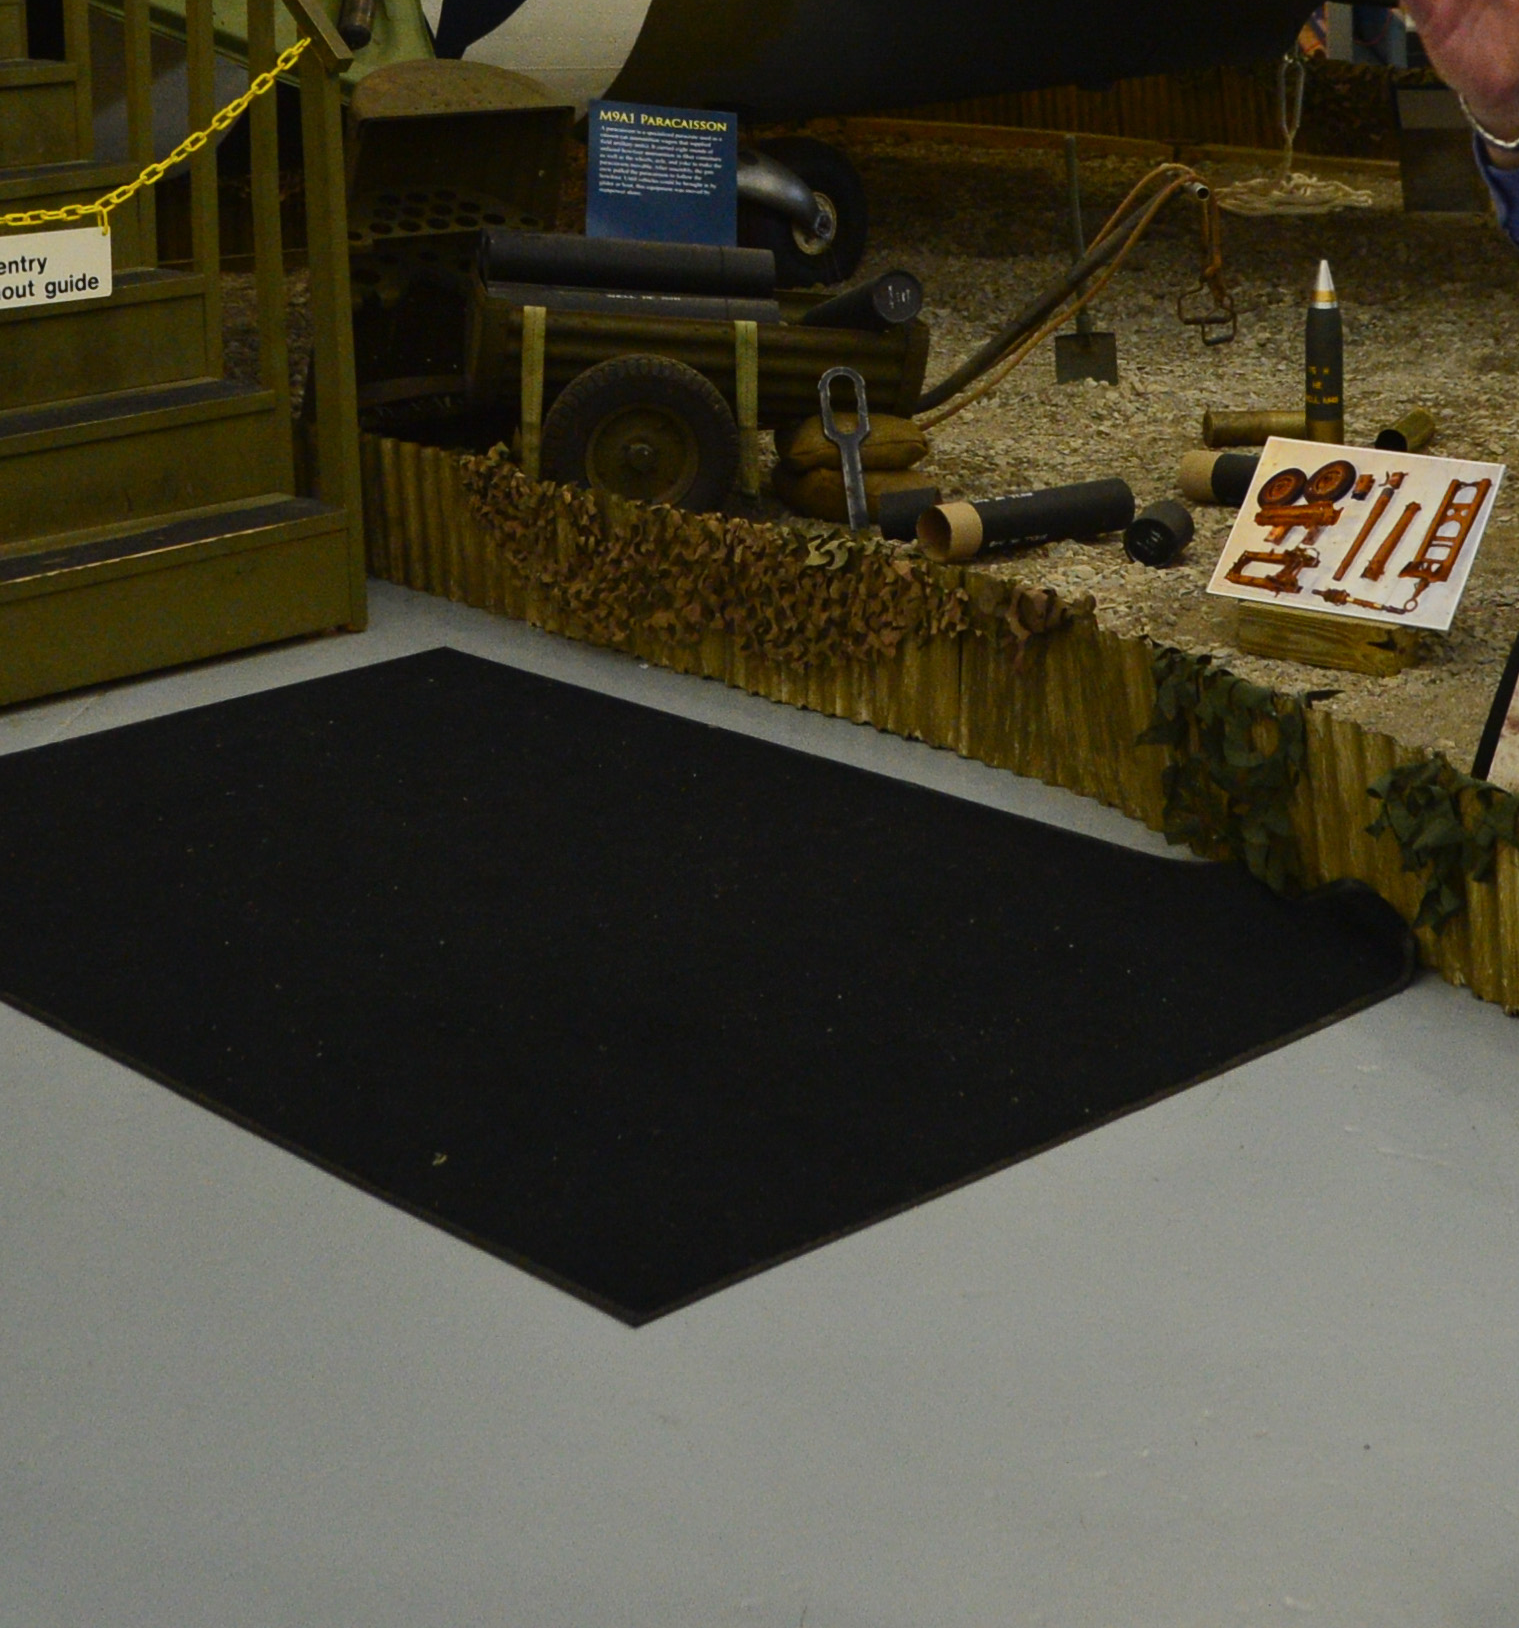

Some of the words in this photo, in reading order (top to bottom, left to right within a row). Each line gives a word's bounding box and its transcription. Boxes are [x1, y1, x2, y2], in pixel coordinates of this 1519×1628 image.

[599, 109, 635, 125] M9A1
[640, 113, 727, 132] PARACAISSON
[44, 273, 100, 299] guide
